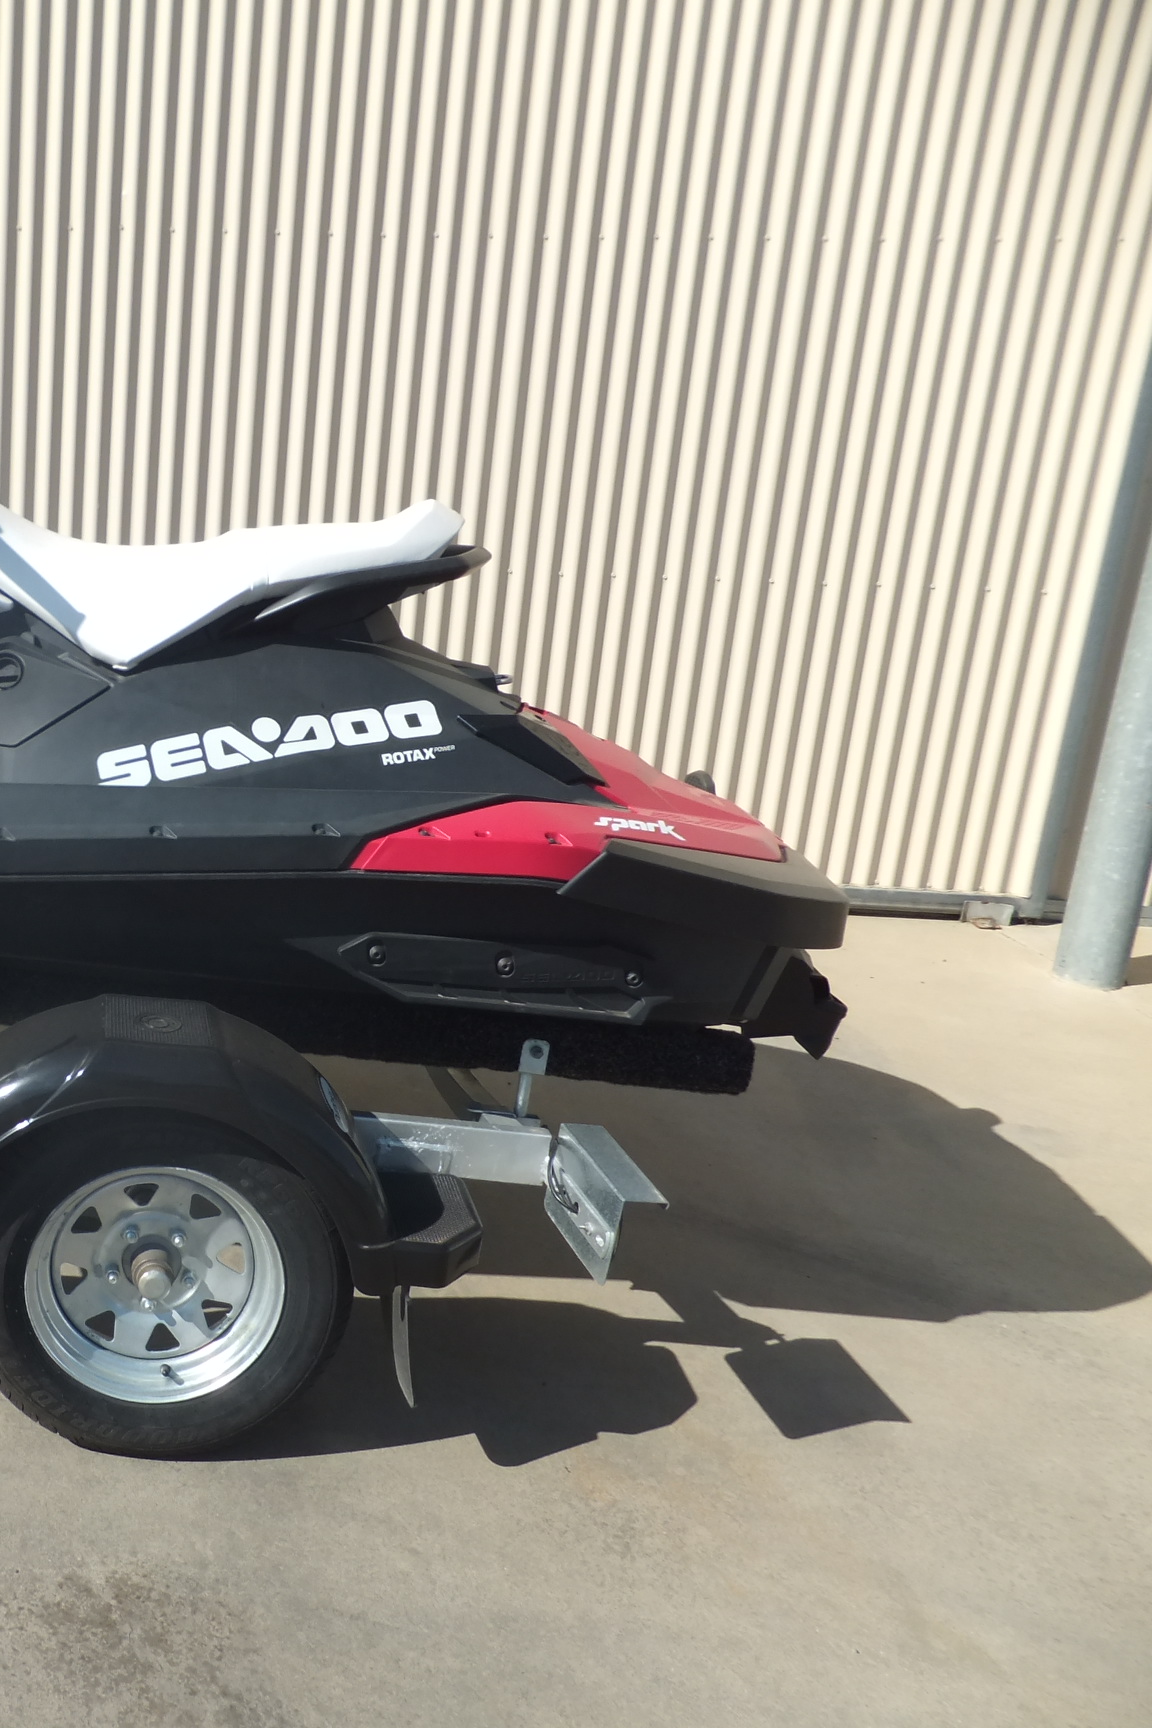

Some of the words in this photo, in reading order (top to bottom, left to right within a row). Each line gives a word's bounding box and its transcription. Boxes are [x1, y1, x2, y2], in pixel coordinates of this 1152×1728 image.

[381, 747, 436, 766] ROTAX
[433, 744, 456, 753] POWER
[594, 816, 687, 842] spark
